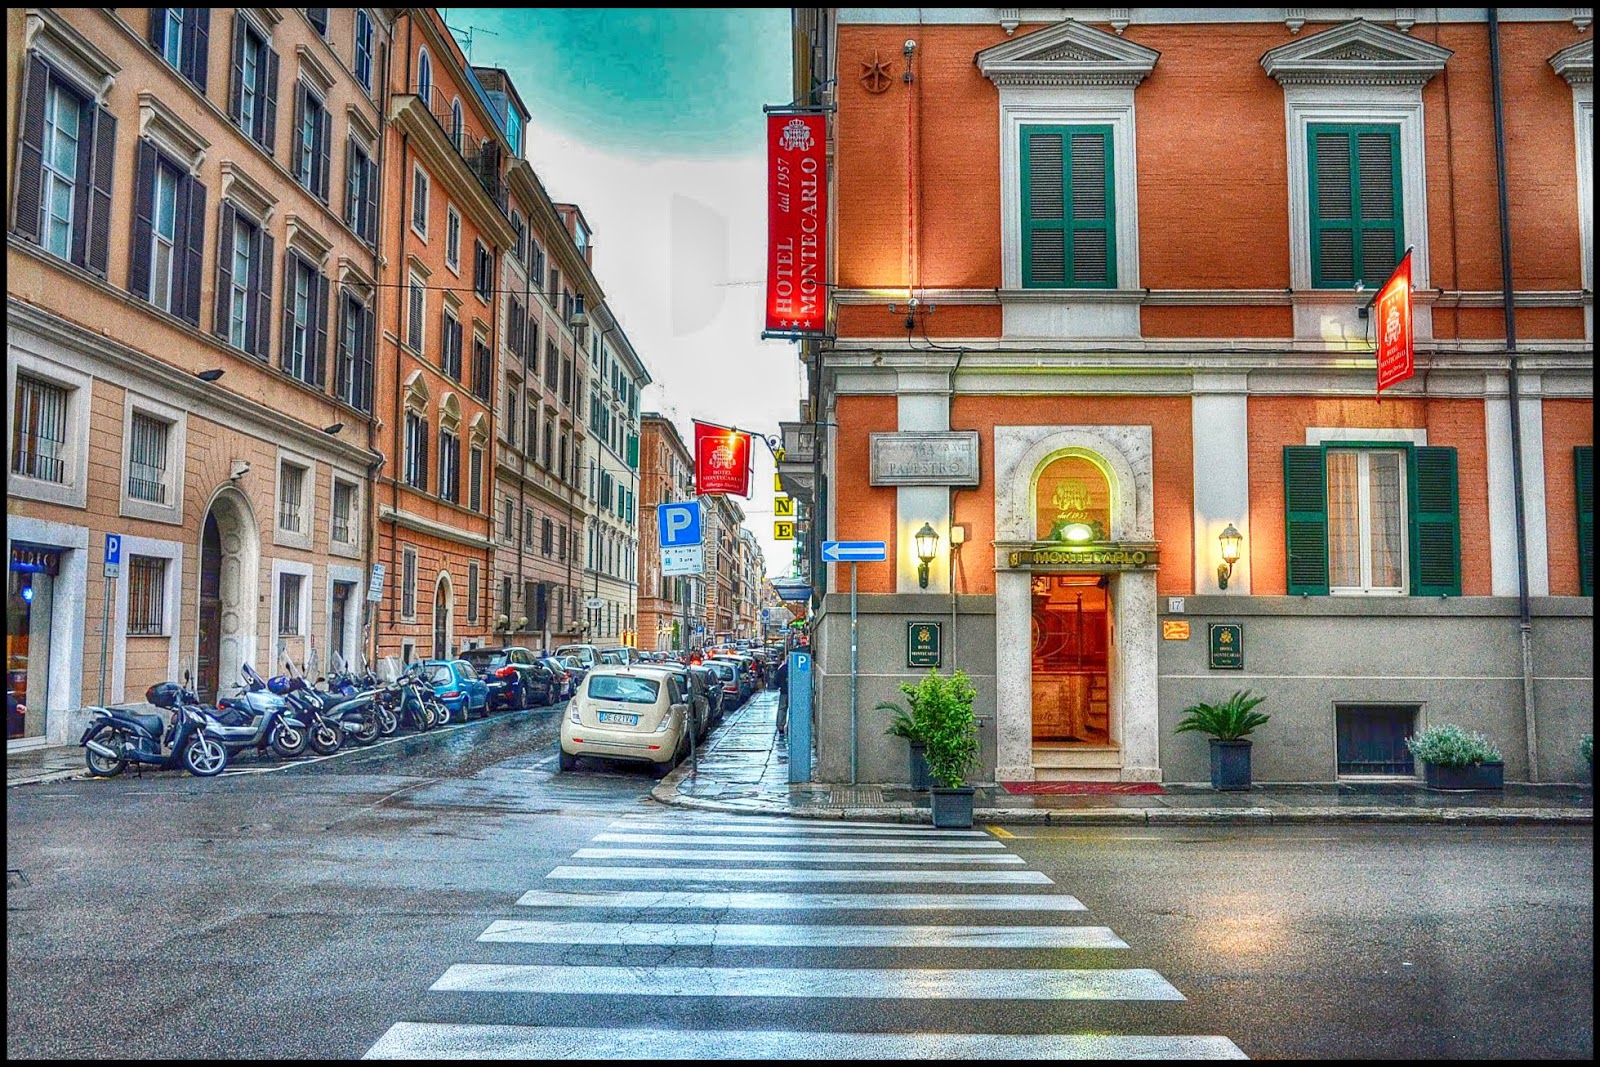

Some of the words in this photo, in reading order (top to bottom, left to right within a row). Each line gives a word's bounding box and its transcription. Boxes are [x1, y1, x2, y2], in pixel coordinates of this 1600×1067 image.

[778, 158, 790, 190] 1957
[778, 192, 790, 213] dal
[801, 157, 818, 315] MONTECARLO
[776, 237, 793, 314] HOTEL
[889, 462, 960, 475] PALESTRO
[666, 508, 692, 542] P
[108, 537, 118, 560] P
[1033, 551, 1146, 564] MONTECARLO
[1172, 600, 1181, 611] 17
[798, 655, 807, 669] P
